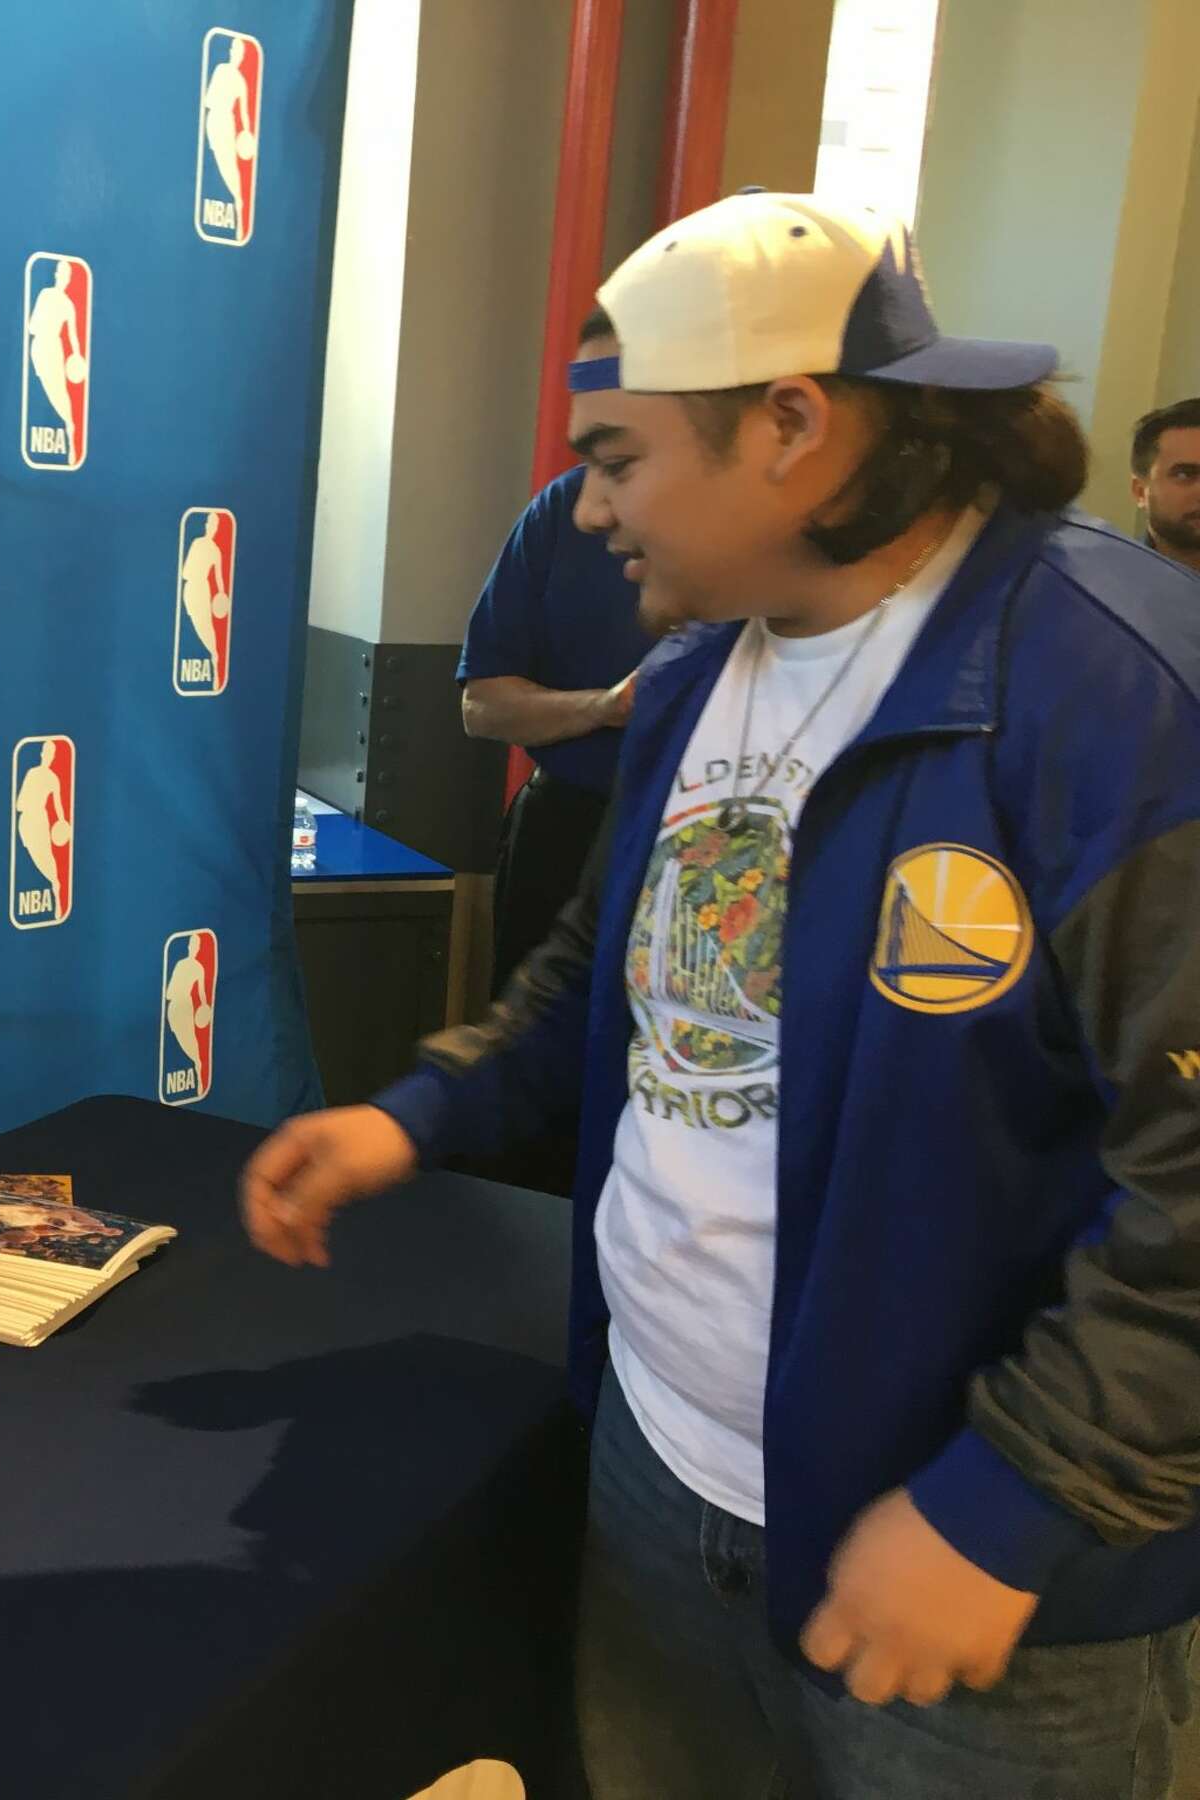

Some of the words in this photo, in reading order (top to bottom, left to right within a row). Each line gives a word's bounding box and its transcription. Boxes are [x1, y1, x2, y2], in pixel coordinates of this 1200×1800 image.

[203, 198, 236, 230] NBA
[31, 426, 67, 455] NBA
[180, 658, 212, 682] NBA
[19, 889, 52, 916] NBA
[166, 1067, 196, 1095] NBA
